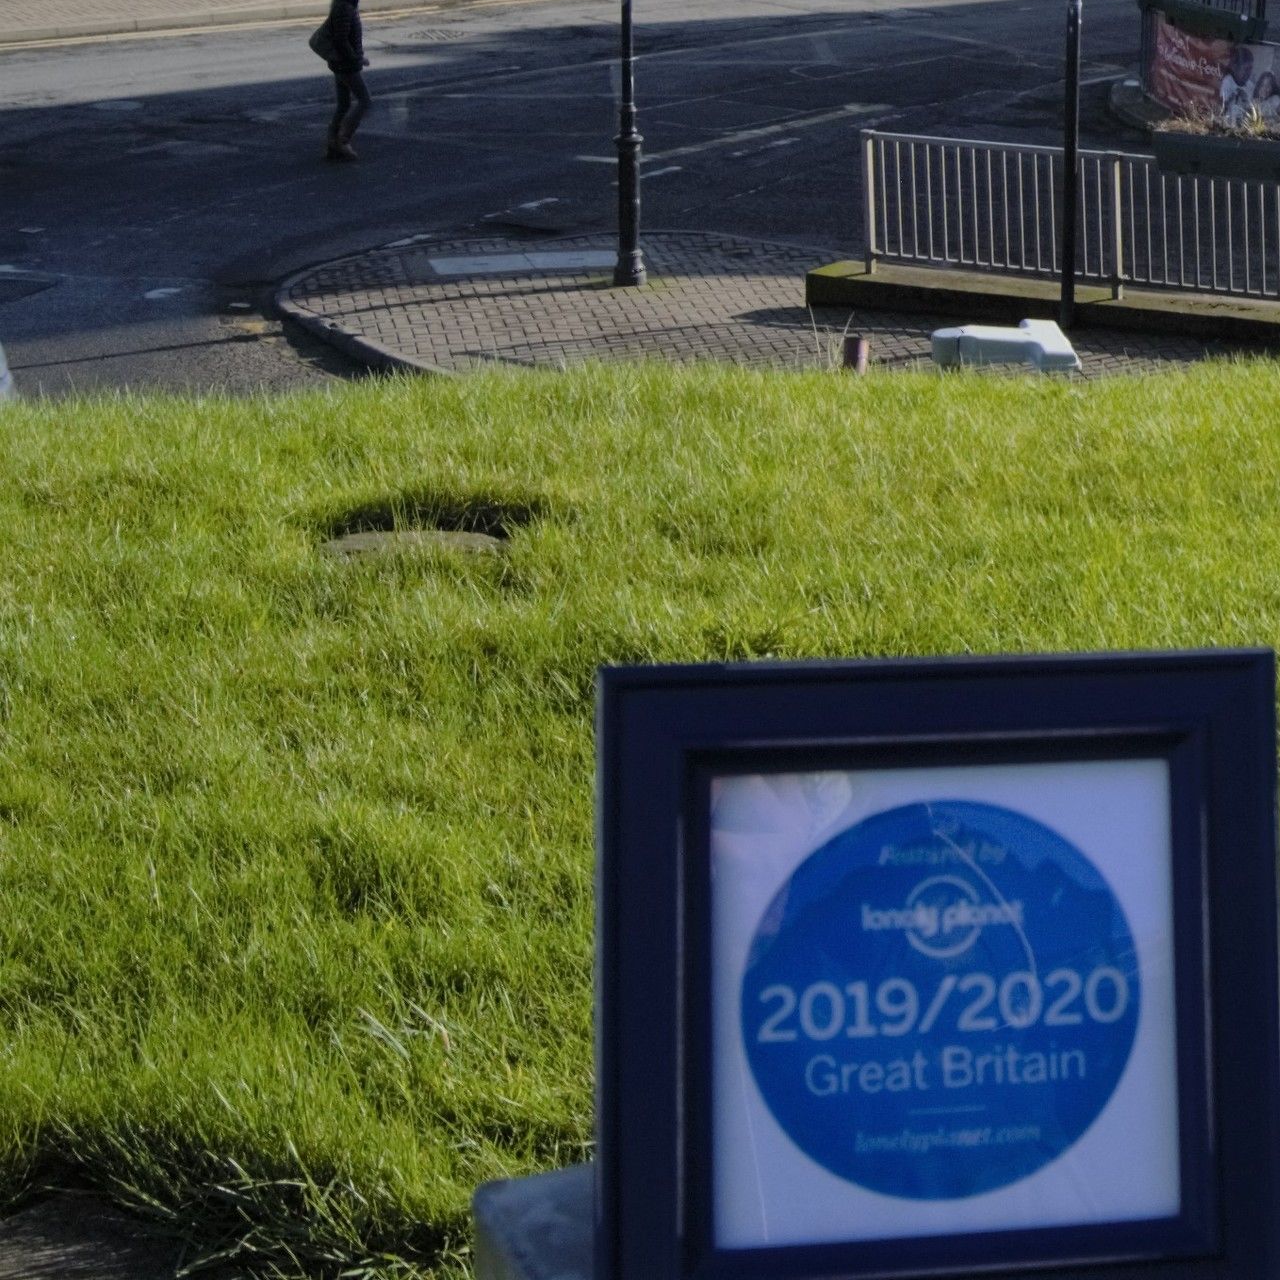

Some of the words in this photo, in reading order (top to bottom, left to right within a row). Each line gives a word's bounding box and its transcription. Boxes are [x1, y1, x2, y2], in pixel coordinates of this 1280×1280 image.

[861, 900, 940, 939] lonely
[942, 897, 1026, 935] planet
[756, 966, 1130, 1043] 2019/2020
[804, 1048, 929, 1097] Great
[941, 1042, 1087, 1089] Britain
